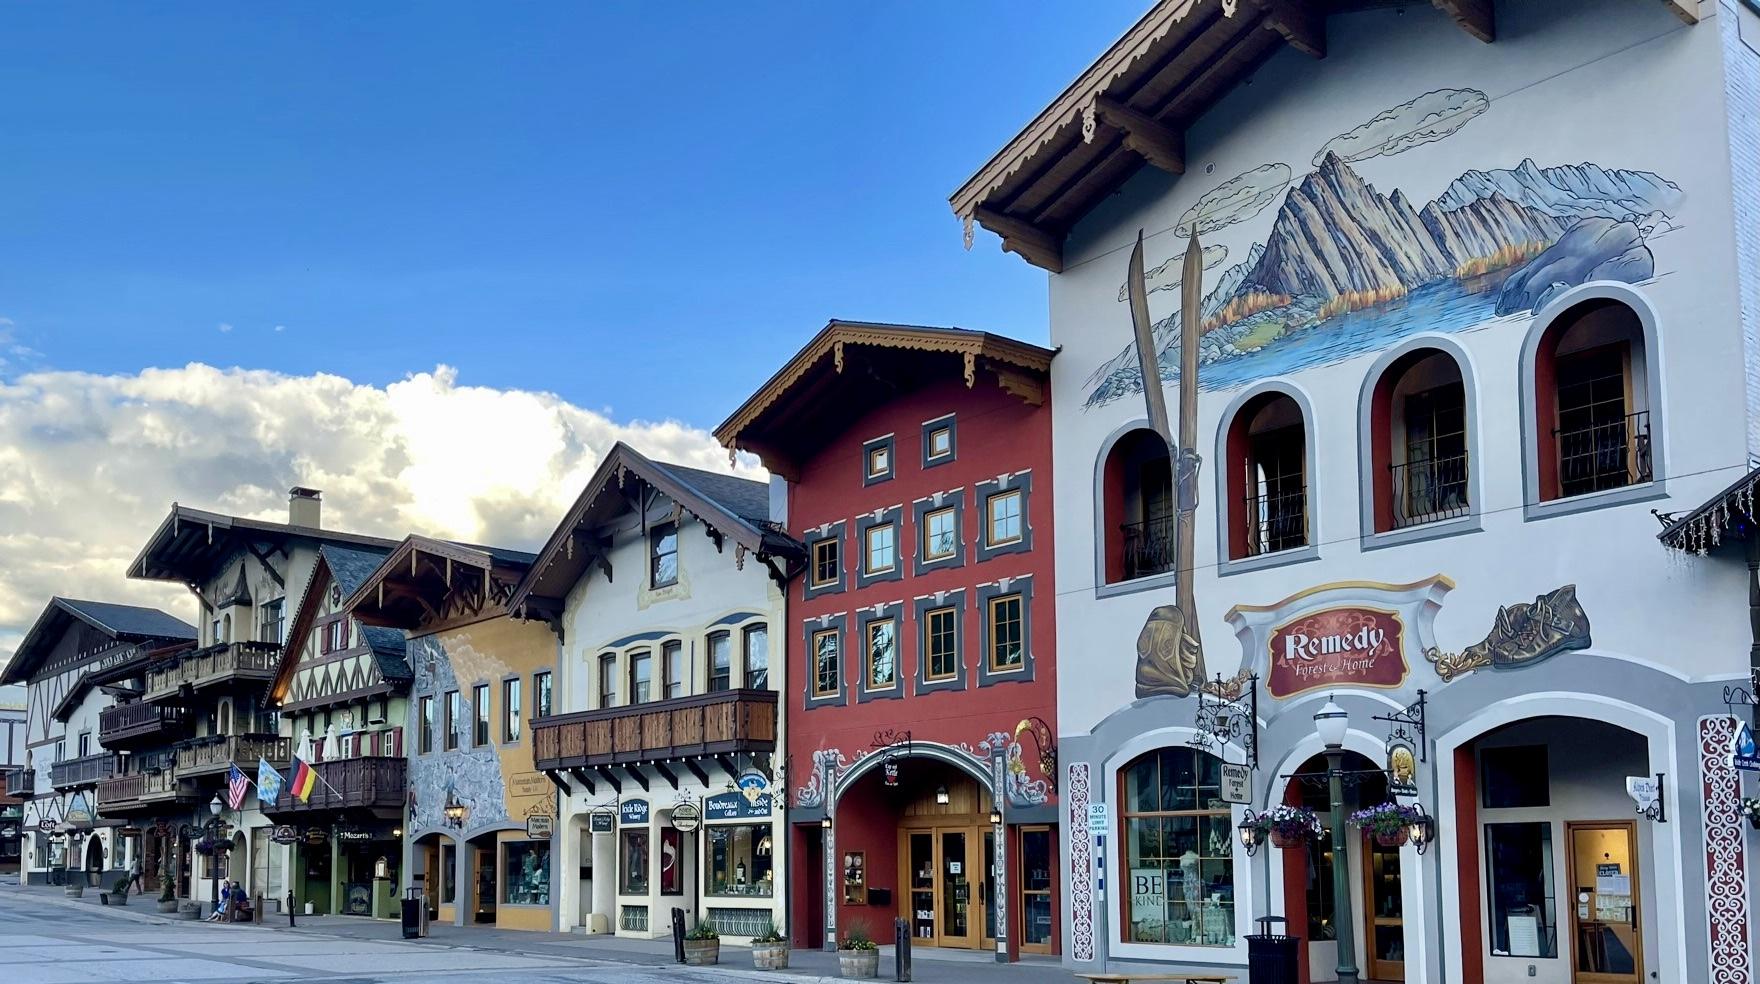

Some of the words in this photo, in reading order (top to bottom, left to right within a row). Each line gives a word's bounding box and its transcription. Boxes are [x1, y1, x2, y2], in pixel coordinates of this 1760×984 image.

[1285, 626, 1384, 660] Remedy
[1295, 663, 1326, 676] Forest
[1341, 658, 1375, 671] Home
[1223, 766, 1249, 781] Remedy
[1092, 805, 1104, 813] 30
[1135, 875, 1163, 895] BE
